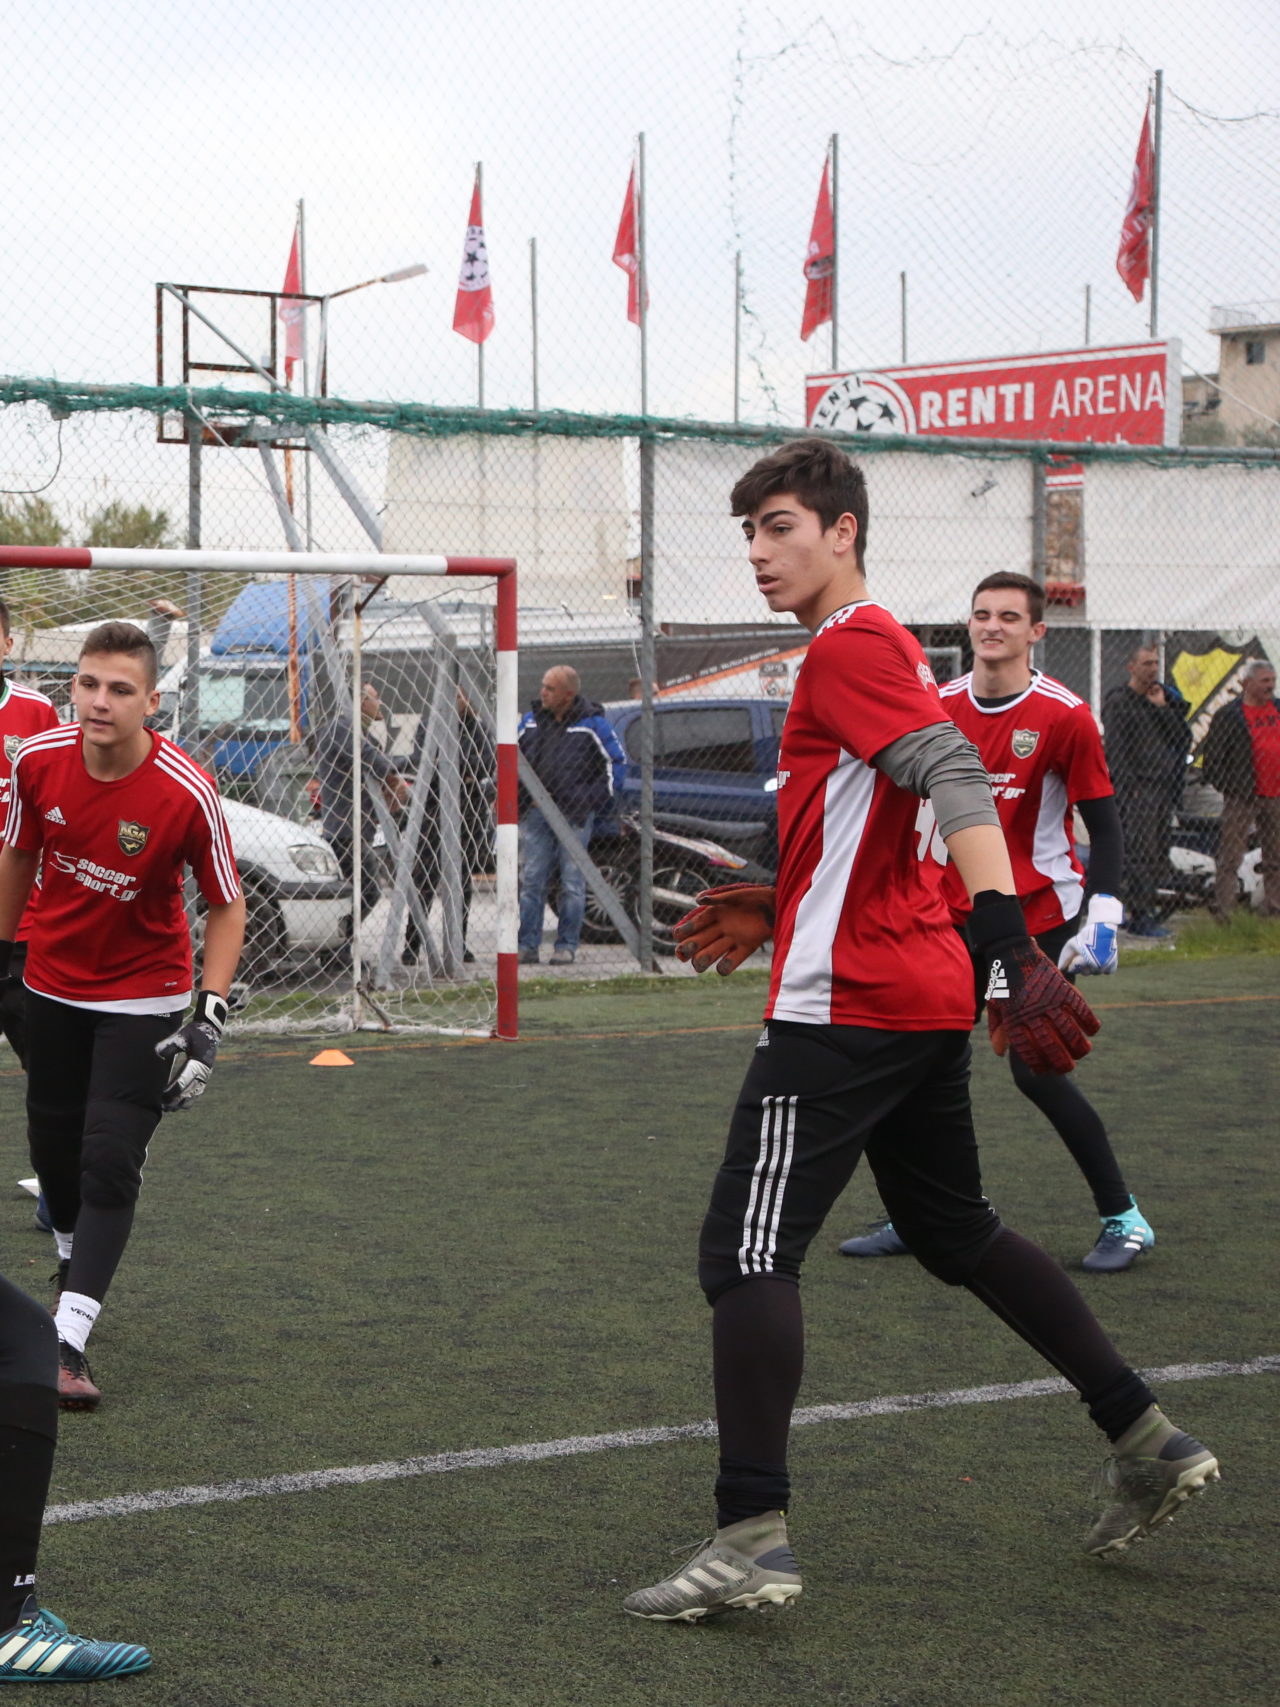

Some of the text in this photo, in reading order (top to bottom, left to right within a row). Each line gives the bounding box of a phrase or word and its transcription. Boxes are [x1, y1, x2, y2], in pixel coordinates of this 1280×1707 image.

[919, 370, 1166, 430] RENTI ARENA
[76, 858, 137, 887] soccer
